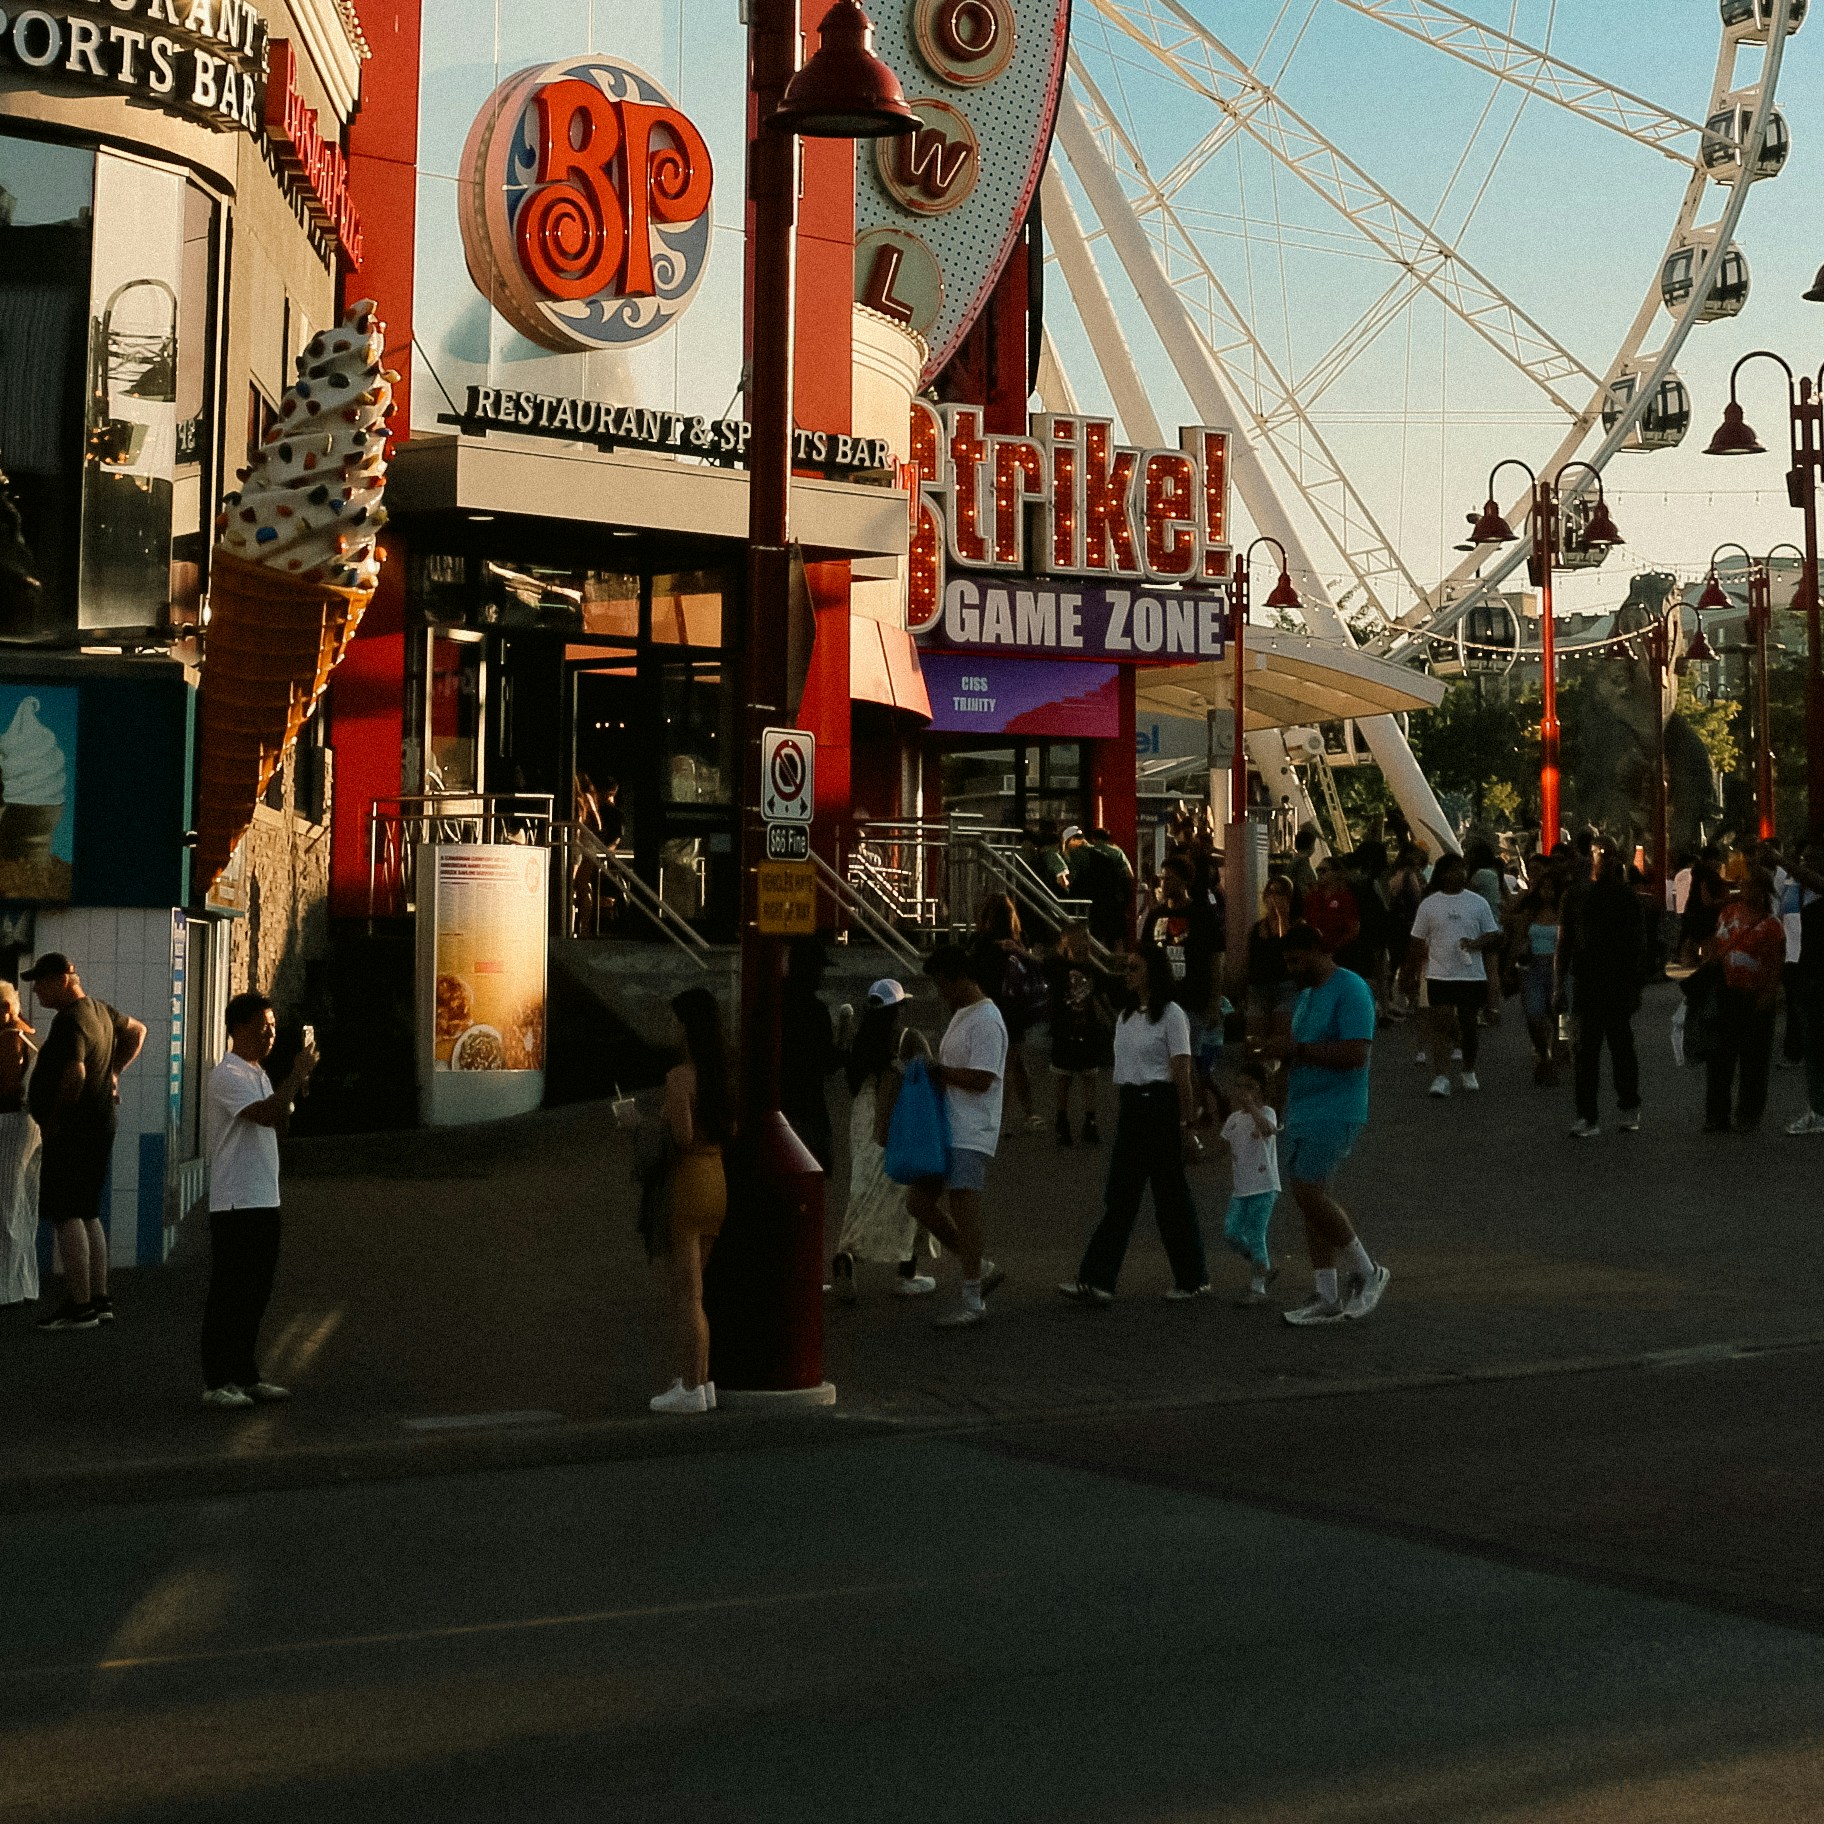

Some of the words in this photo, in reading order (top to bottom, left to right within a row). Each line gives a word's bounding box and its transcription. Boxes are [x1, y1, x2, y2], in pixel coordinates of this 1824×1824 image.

[192, 48, 258, 133] BAR
[475, 386, 684, 447] RESTAURANT
[690, 416, 713, 448] &
[720, 419, 826, 462] SPTS
[834, 438, 891, 471] BAR
[944, 580, 1085, 649] GAME
[1103, 588, 1223, 655] ZONE
[787, 828, 807, 854] Fine
